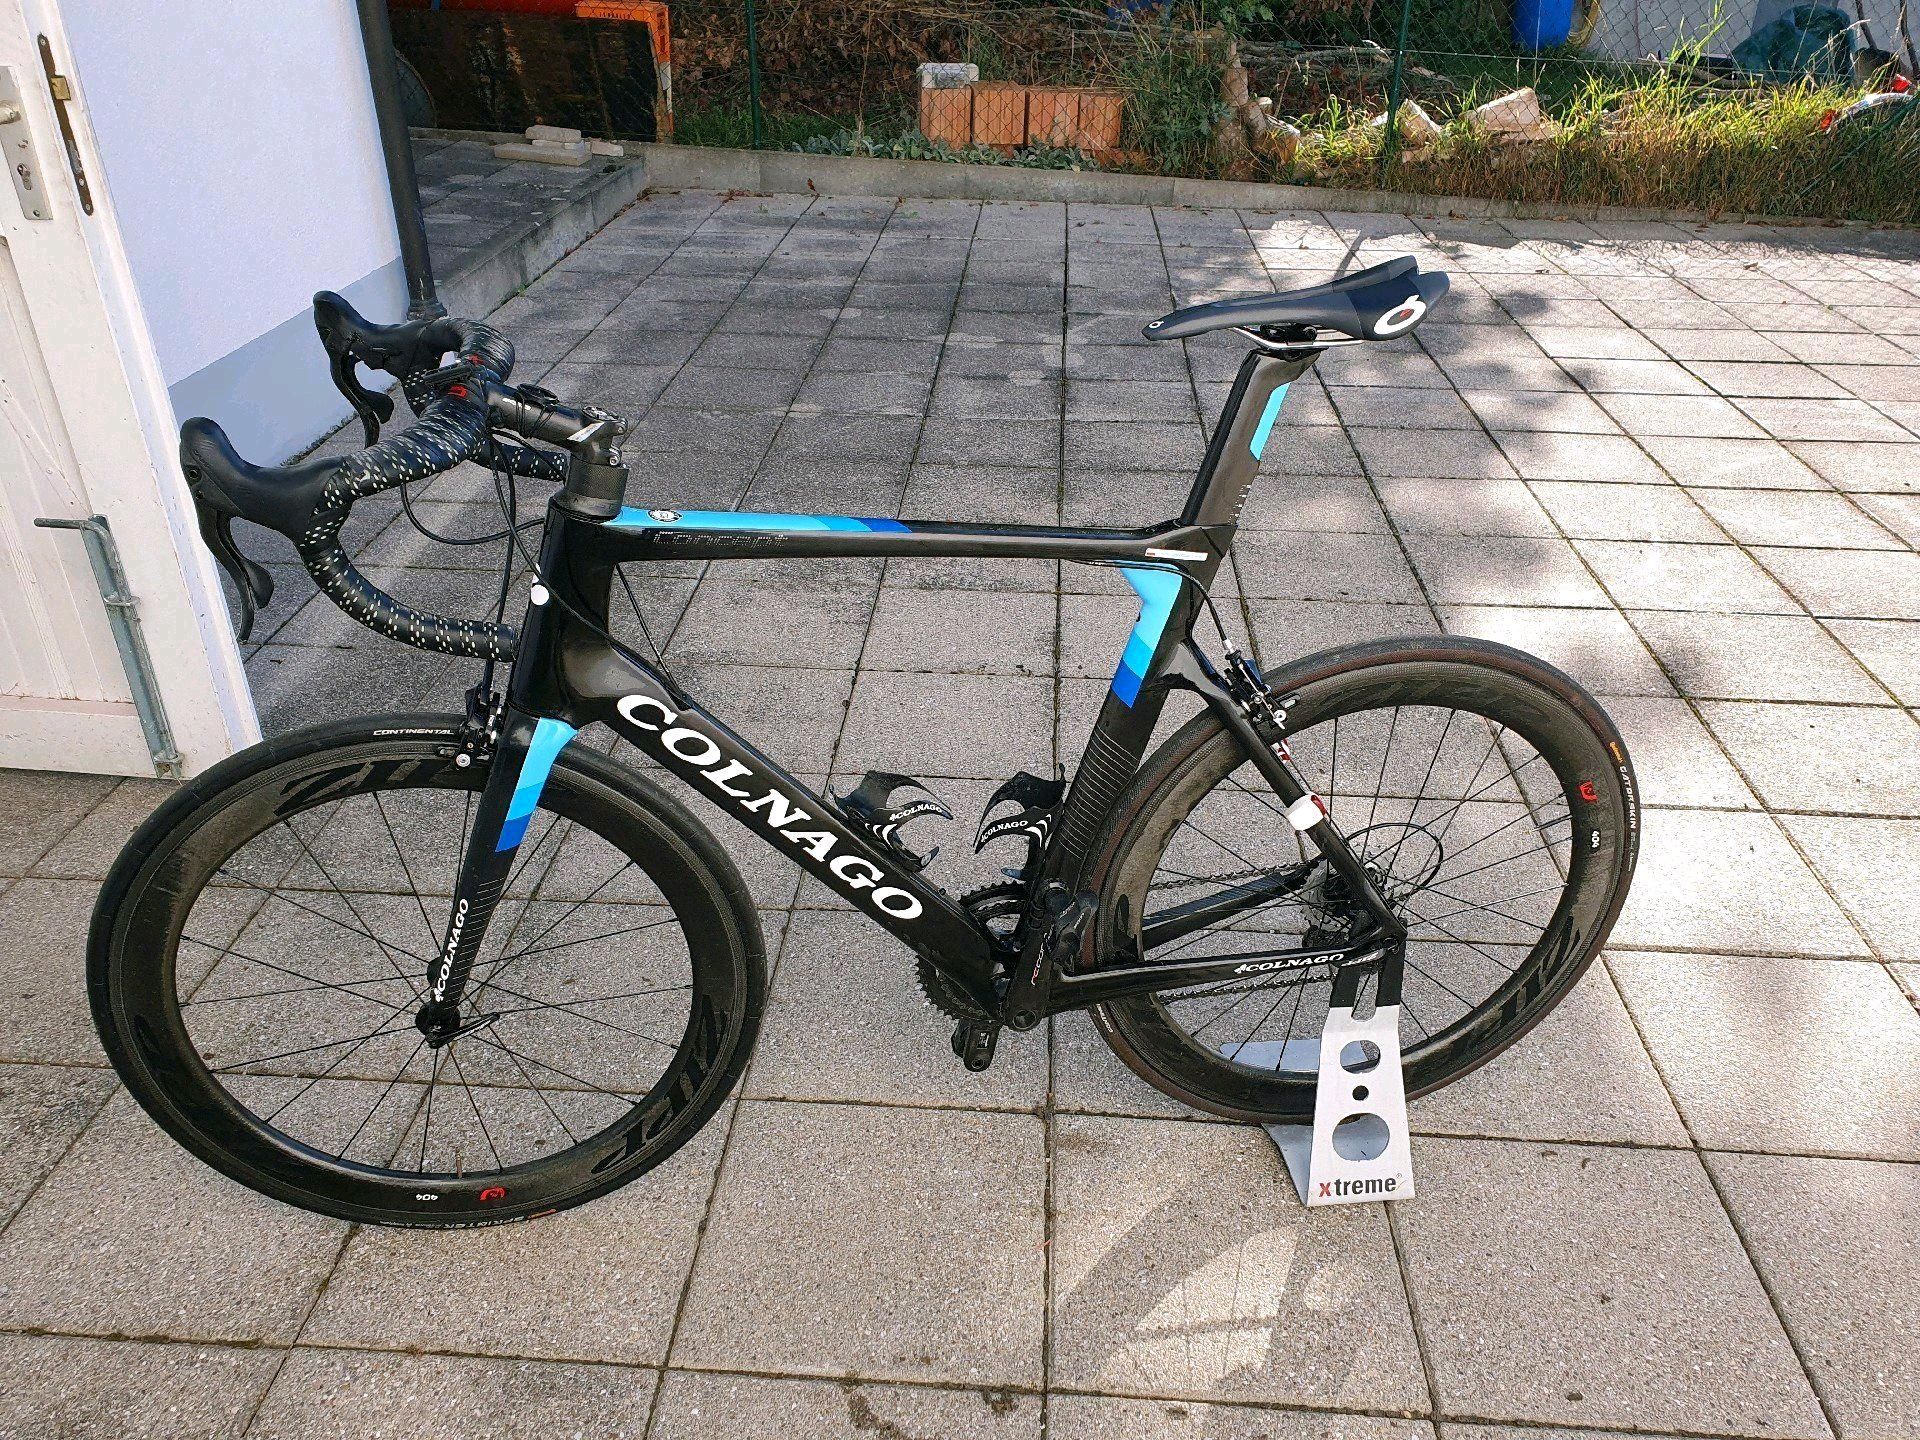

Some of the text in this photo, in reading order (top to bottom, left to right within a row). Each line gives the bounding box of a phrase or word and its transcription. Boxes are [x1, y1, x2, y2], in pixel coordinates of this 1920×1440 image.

[373, 728, 454, 736] CONTINENTAL
[617, 694, 922, 919] COLNAGO
[896, 803, 943, 819] COLNAGO
[984, 820, 1028, 839] COLNAGO
[1592, 830, 1600, 848] 404
[438, 899, 468, 991] COLNAGO
[1246, 954, 1344, 972] COLNAGO
[1319, 1177, 1397, 1197] xtreme
[416, 1193, 439, 1201] 404
